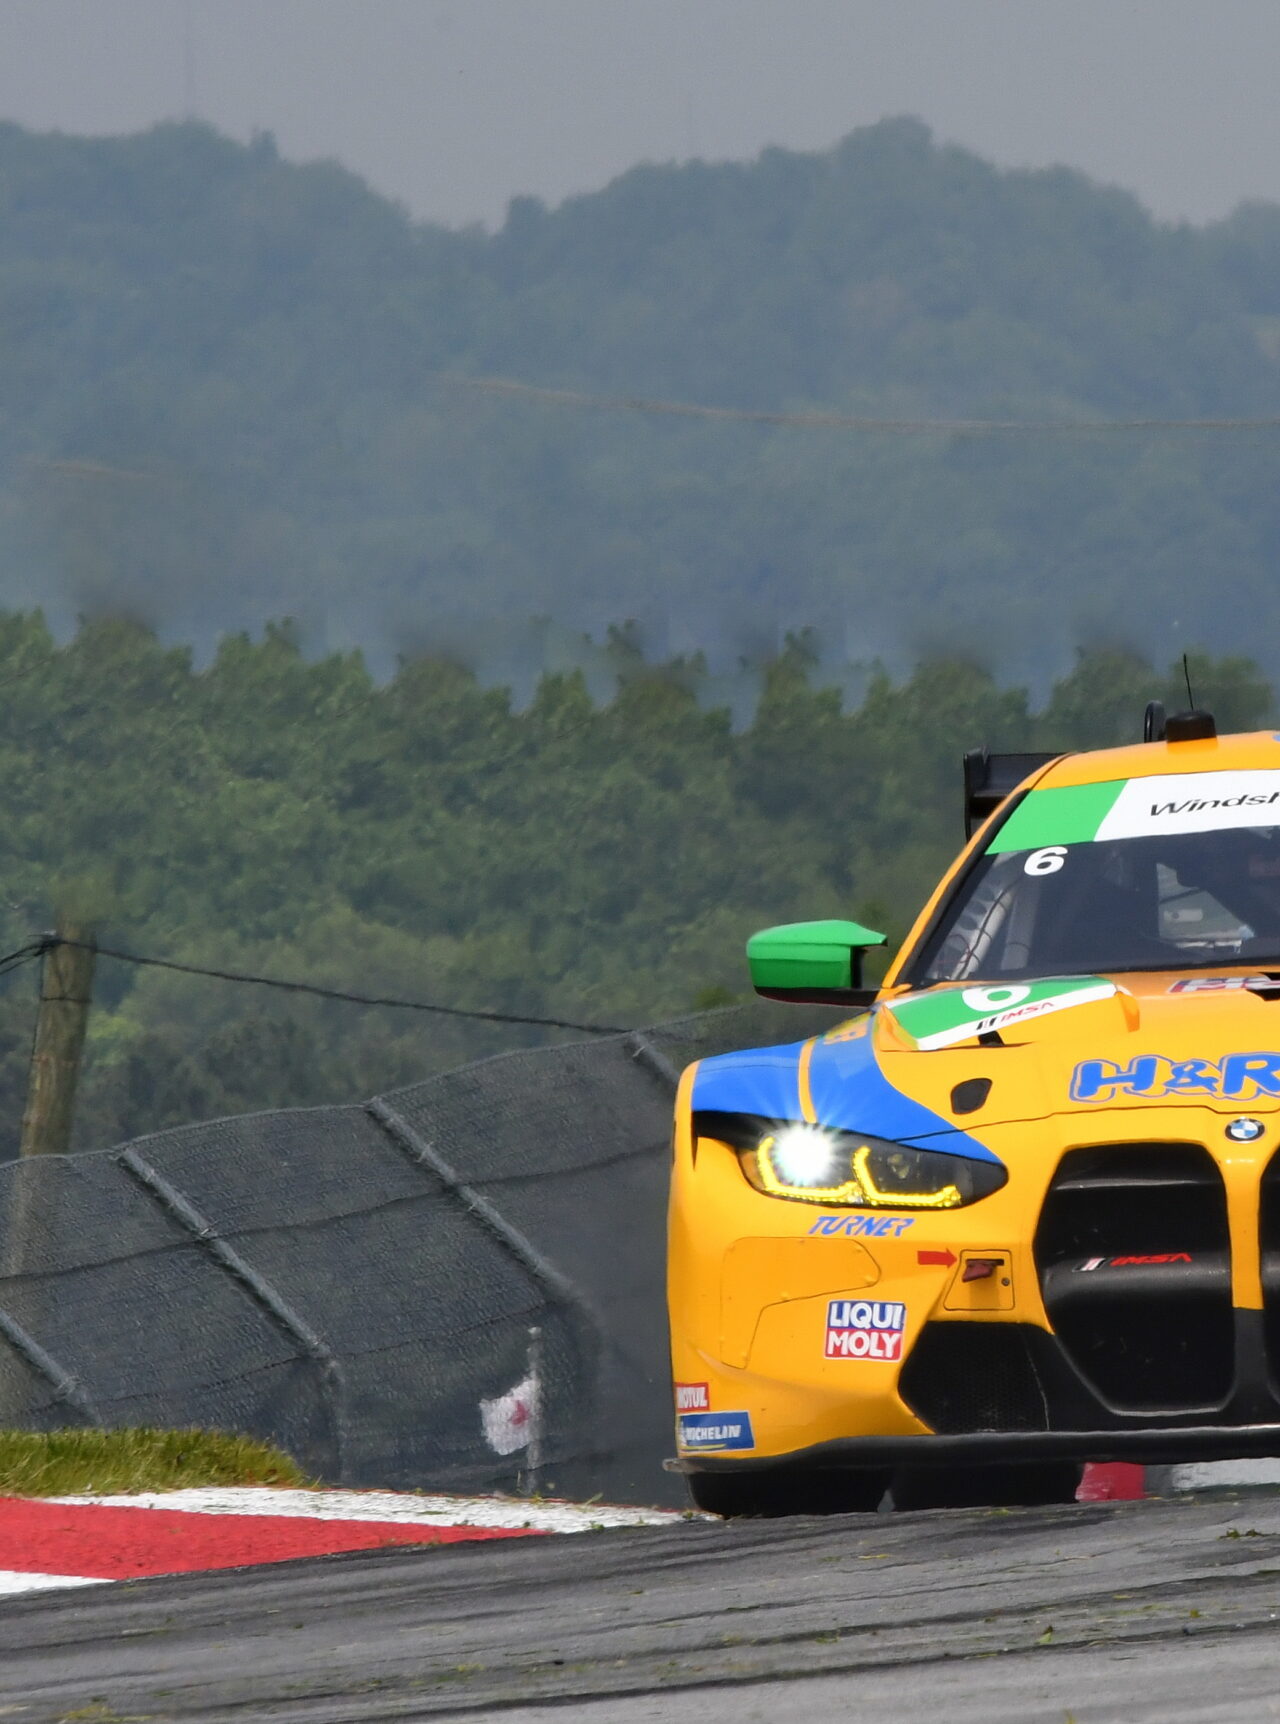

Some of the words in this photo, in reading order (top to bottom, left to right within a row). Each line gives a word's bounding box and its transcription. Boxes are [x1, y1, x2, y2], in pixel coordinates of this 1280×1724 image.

[1024, 845, 1068, 876] 6
[808, 1216, 914, 1237] TURNER
[829, 1302, 903, 1329] LIQUI
[827, 1330, 900, 1358] MOLY
